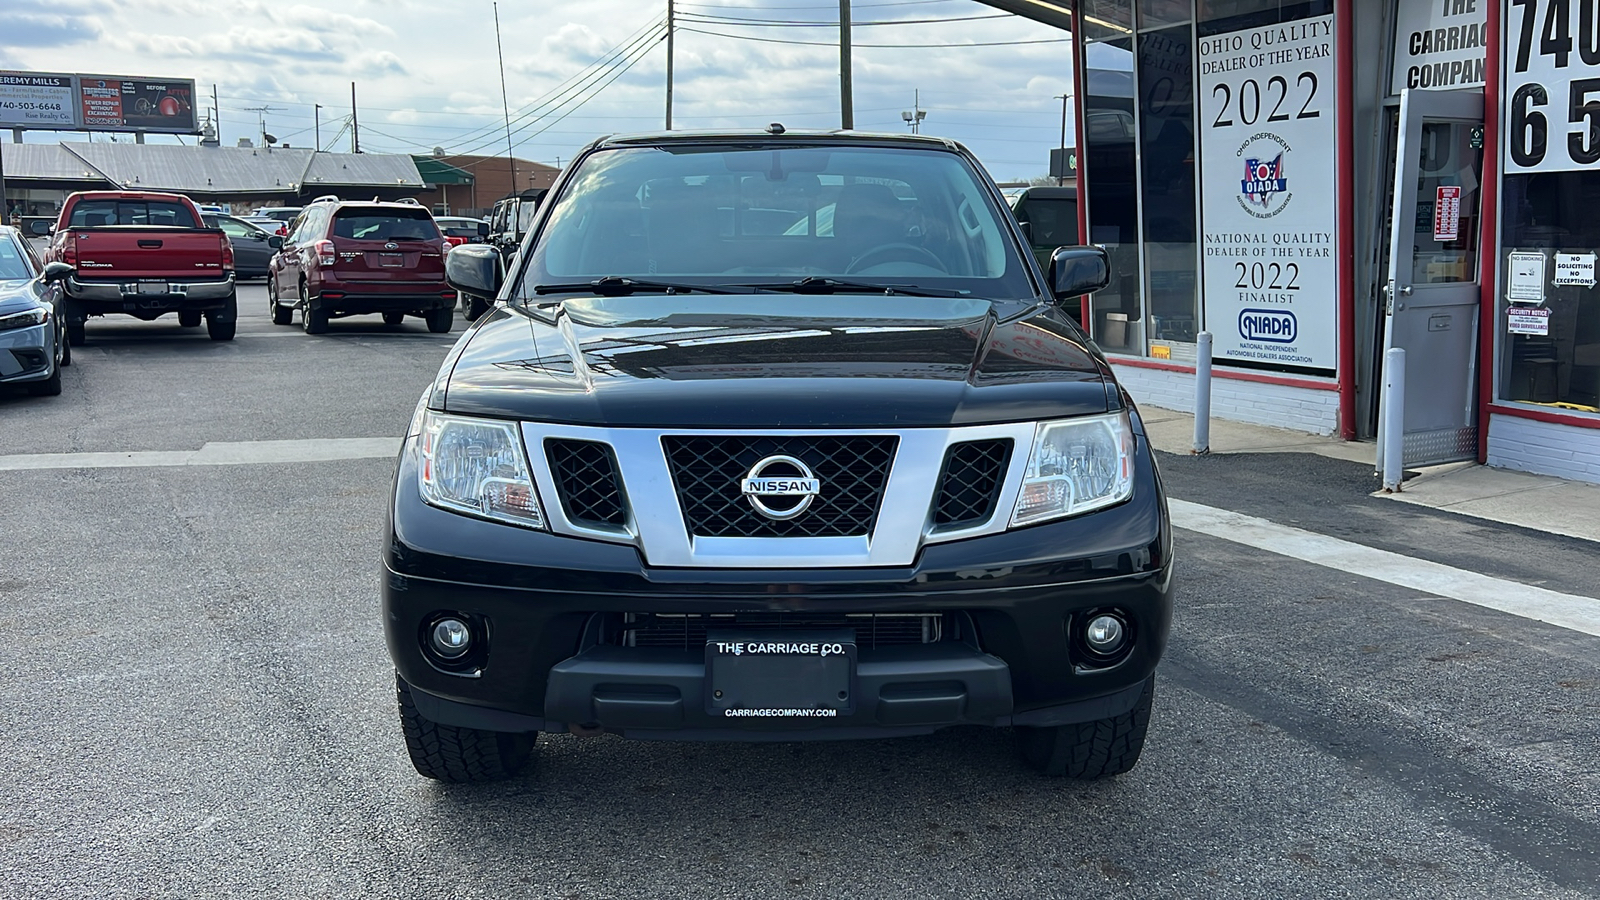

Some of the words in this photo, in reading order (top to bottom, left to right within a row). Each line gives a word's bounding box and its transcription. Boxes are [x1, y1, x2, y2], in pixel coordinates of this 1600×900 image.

[1442, 0, 1476, 17] THE
[1200, 35, 1243, 56] OHIO
[1251, 19, 1332, 50] QUALITY
[1512, 0, 1600, 73] 740
[1203, 56, 1246, 75] DEALER
[1249, 54, 1265, 69] OF
[1267, 49, 1293, 65] THE
[1296, 43, 1330, 61] YEAR
[32, 77, 60, 86] MILLS
[1212, 71, 1320, 128] 2022
[39, 112, 58, 121] Realty
[1236, 139, 1250, 157] OHIO
[1250, 132, 1292, 153] INDEPENDENT
[1246, 180, 1279, 193] OIADA
[1236, 195, 1255, 217] AUTOMOBILE
[1272, 192, 1293, 217] ASSOCIATION
[1205, 233, 1267, 244] NATIONAL
[1273, 233, 1332, 245] QUALITY
[1207, 247, 1248, 257] DEALER
[1253, 247, 1266, 256] OF
[1272, 247, 1293, 257] THE
[1299, 247, 1330, 258] YEAR
[1234, 261, 1300, 291] 2022
[1239, 292, 1294, 304] FINALIST
[1510, 308, 1531, 316] SECURITY
[1531, 309, 1548, 317] NOTICE
[1243, 315, 1292, 336] NIADA
[1240, 342, 1263, 350] NATIONAL
[1264, 345, 1298, 353] INDEPENDENT
[1226, 349, 1256, 358] AUTOMOBILE
[1256, 352, 1277, 360] DEALERS
[1278, 355, 1313, 363] ASSOCIATION
[749, 481, 812, 492] NISSAN
[716, 642, 744, 654] THE
[747, 642, 819, 654] CARRIAGE
[821, 643, 845, 655] CO.
[725, 708, 837, 717] CARRIAGECOMPANY.COM
